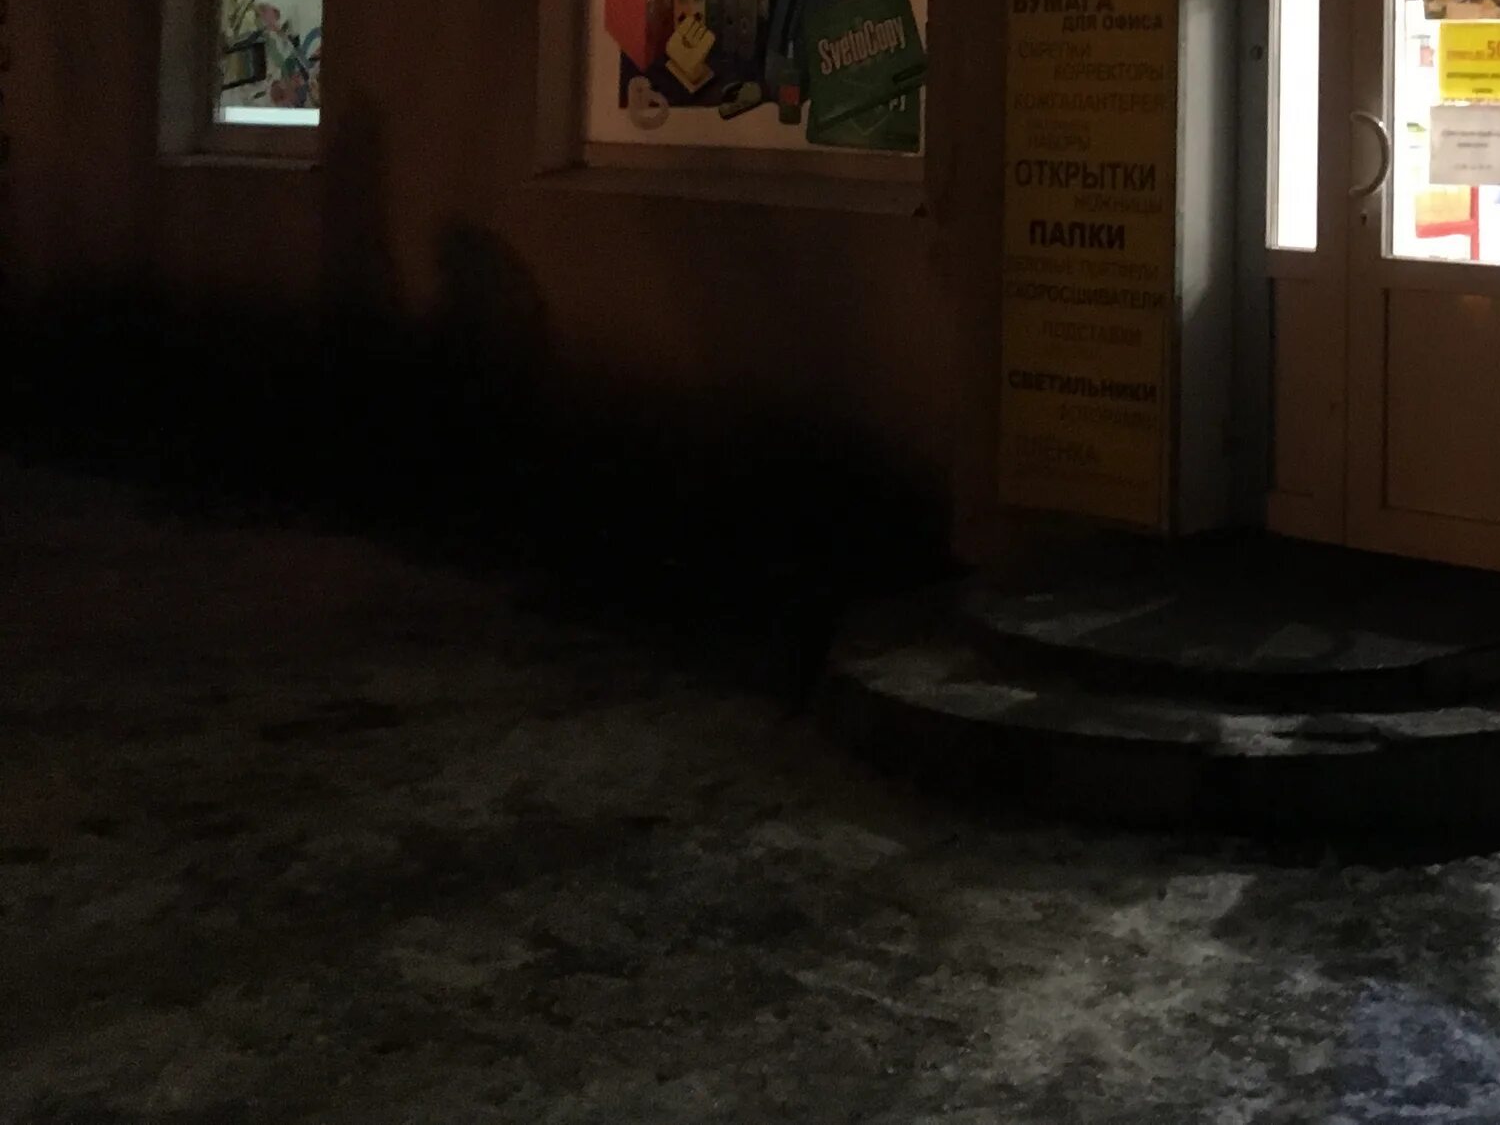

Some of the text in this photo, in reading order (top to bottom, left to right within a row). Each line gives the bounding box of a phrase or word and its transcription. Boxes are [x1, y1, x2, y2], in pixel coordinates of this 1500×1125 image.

[1062, 13, 1164, 34] ДЛЯ ОФИСА
[818, 17, 906, 75] SvetoCopy
[1054, 61, 1165, 82] КОРРЕКТОРЫ
[1014, 158, 1157, 192] ОТКРЫТКИ
[1028, 219, 1127, 250] ПАПКИ
[1005, 280, 1168, 310] СКОРОСШИВАТЕЛИ
[1042, 320, 1143, 346] ПОДСТАВКИ
[1008, 369, 1158, 402] СВЕТИЛЬНИКИ
